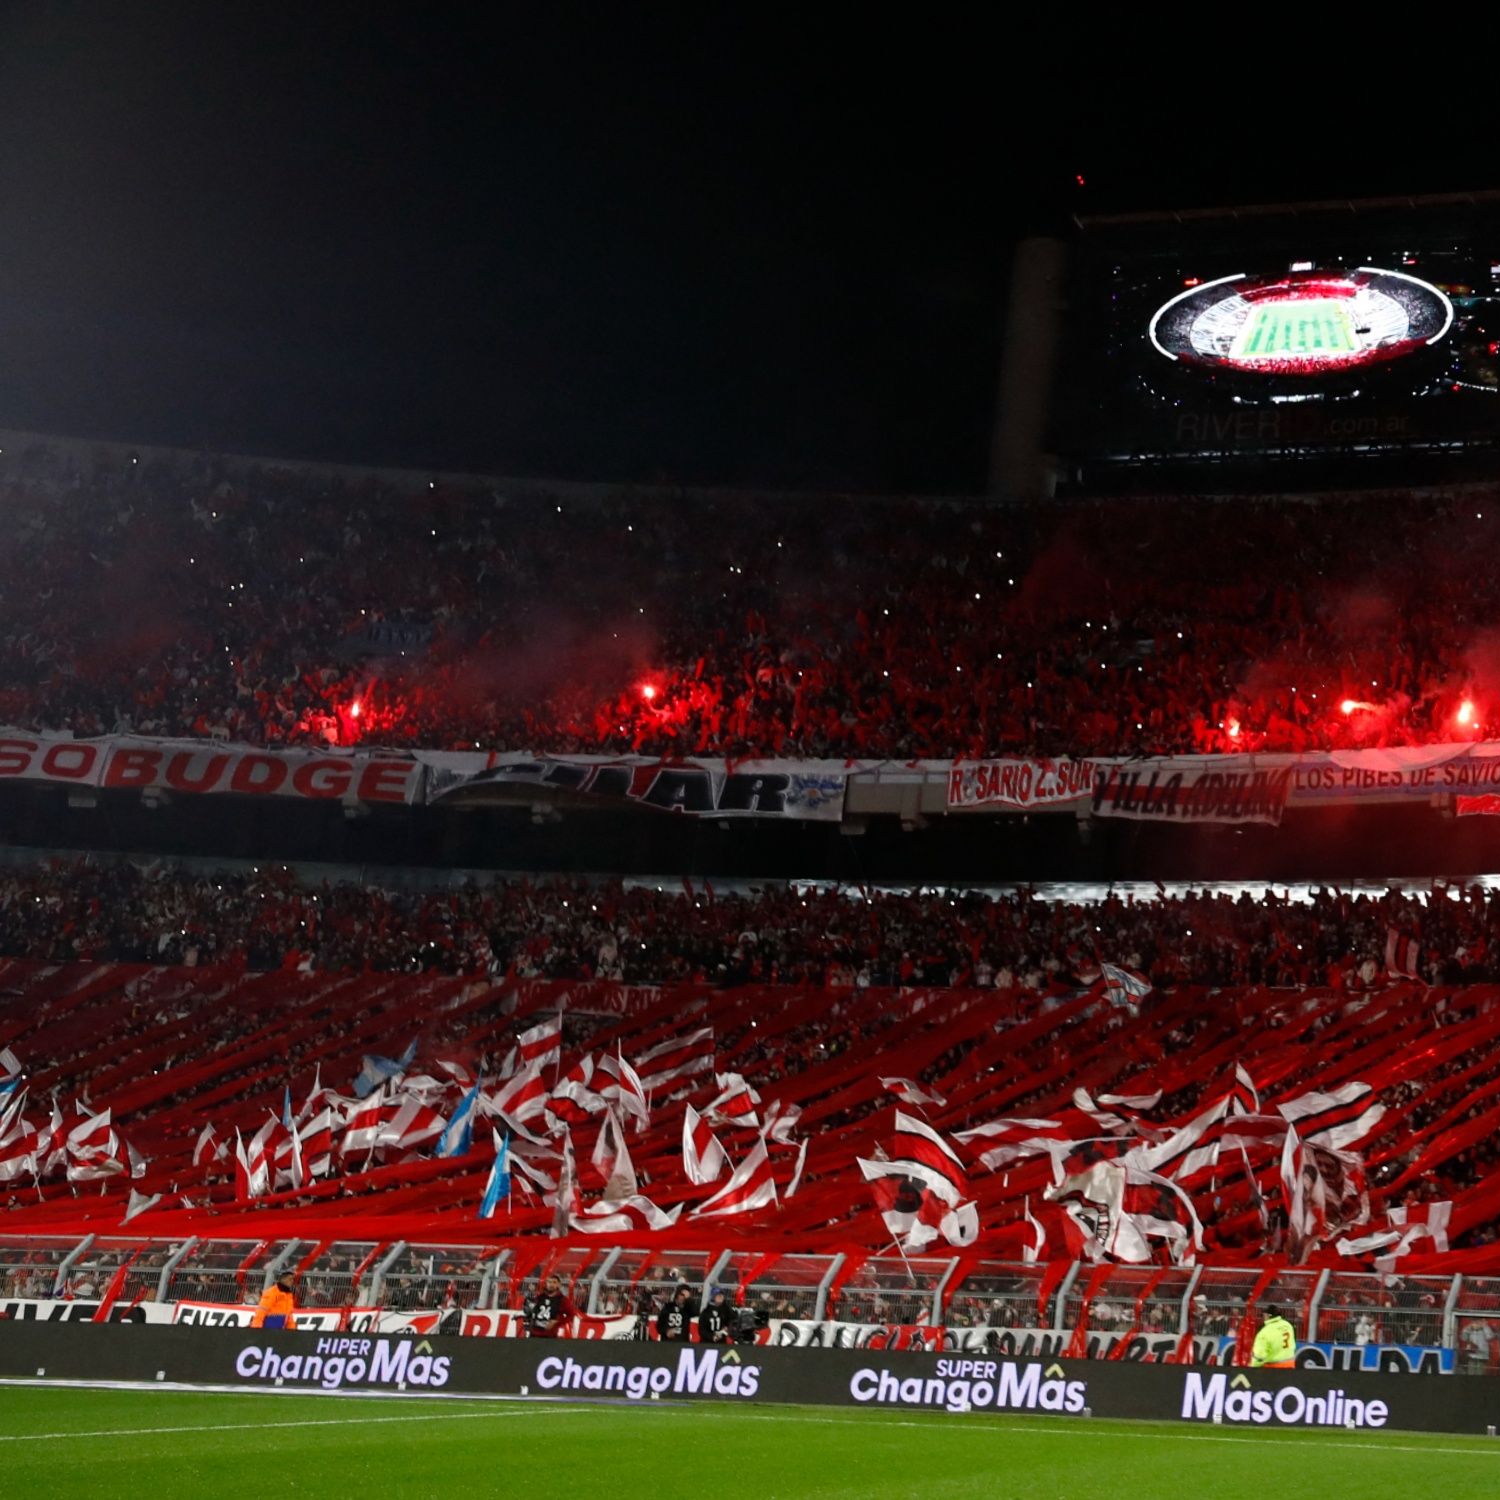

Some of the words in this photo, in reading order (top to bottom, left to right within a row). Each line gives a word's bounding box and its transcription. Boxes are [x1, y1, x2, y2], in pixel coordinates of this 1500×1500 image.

[104, 749, 416, 802] BUDGE
[1056, 759, 1093, 796] SUR
[1295, 766, 1336, 791] LOS
[1343, 767, 1403, 790] PIBES
[1410, 764, 1436, 788] DE
[316, 1337, 372, 1356] HIPER
[936, 1359, 997, 1379] SUPER
